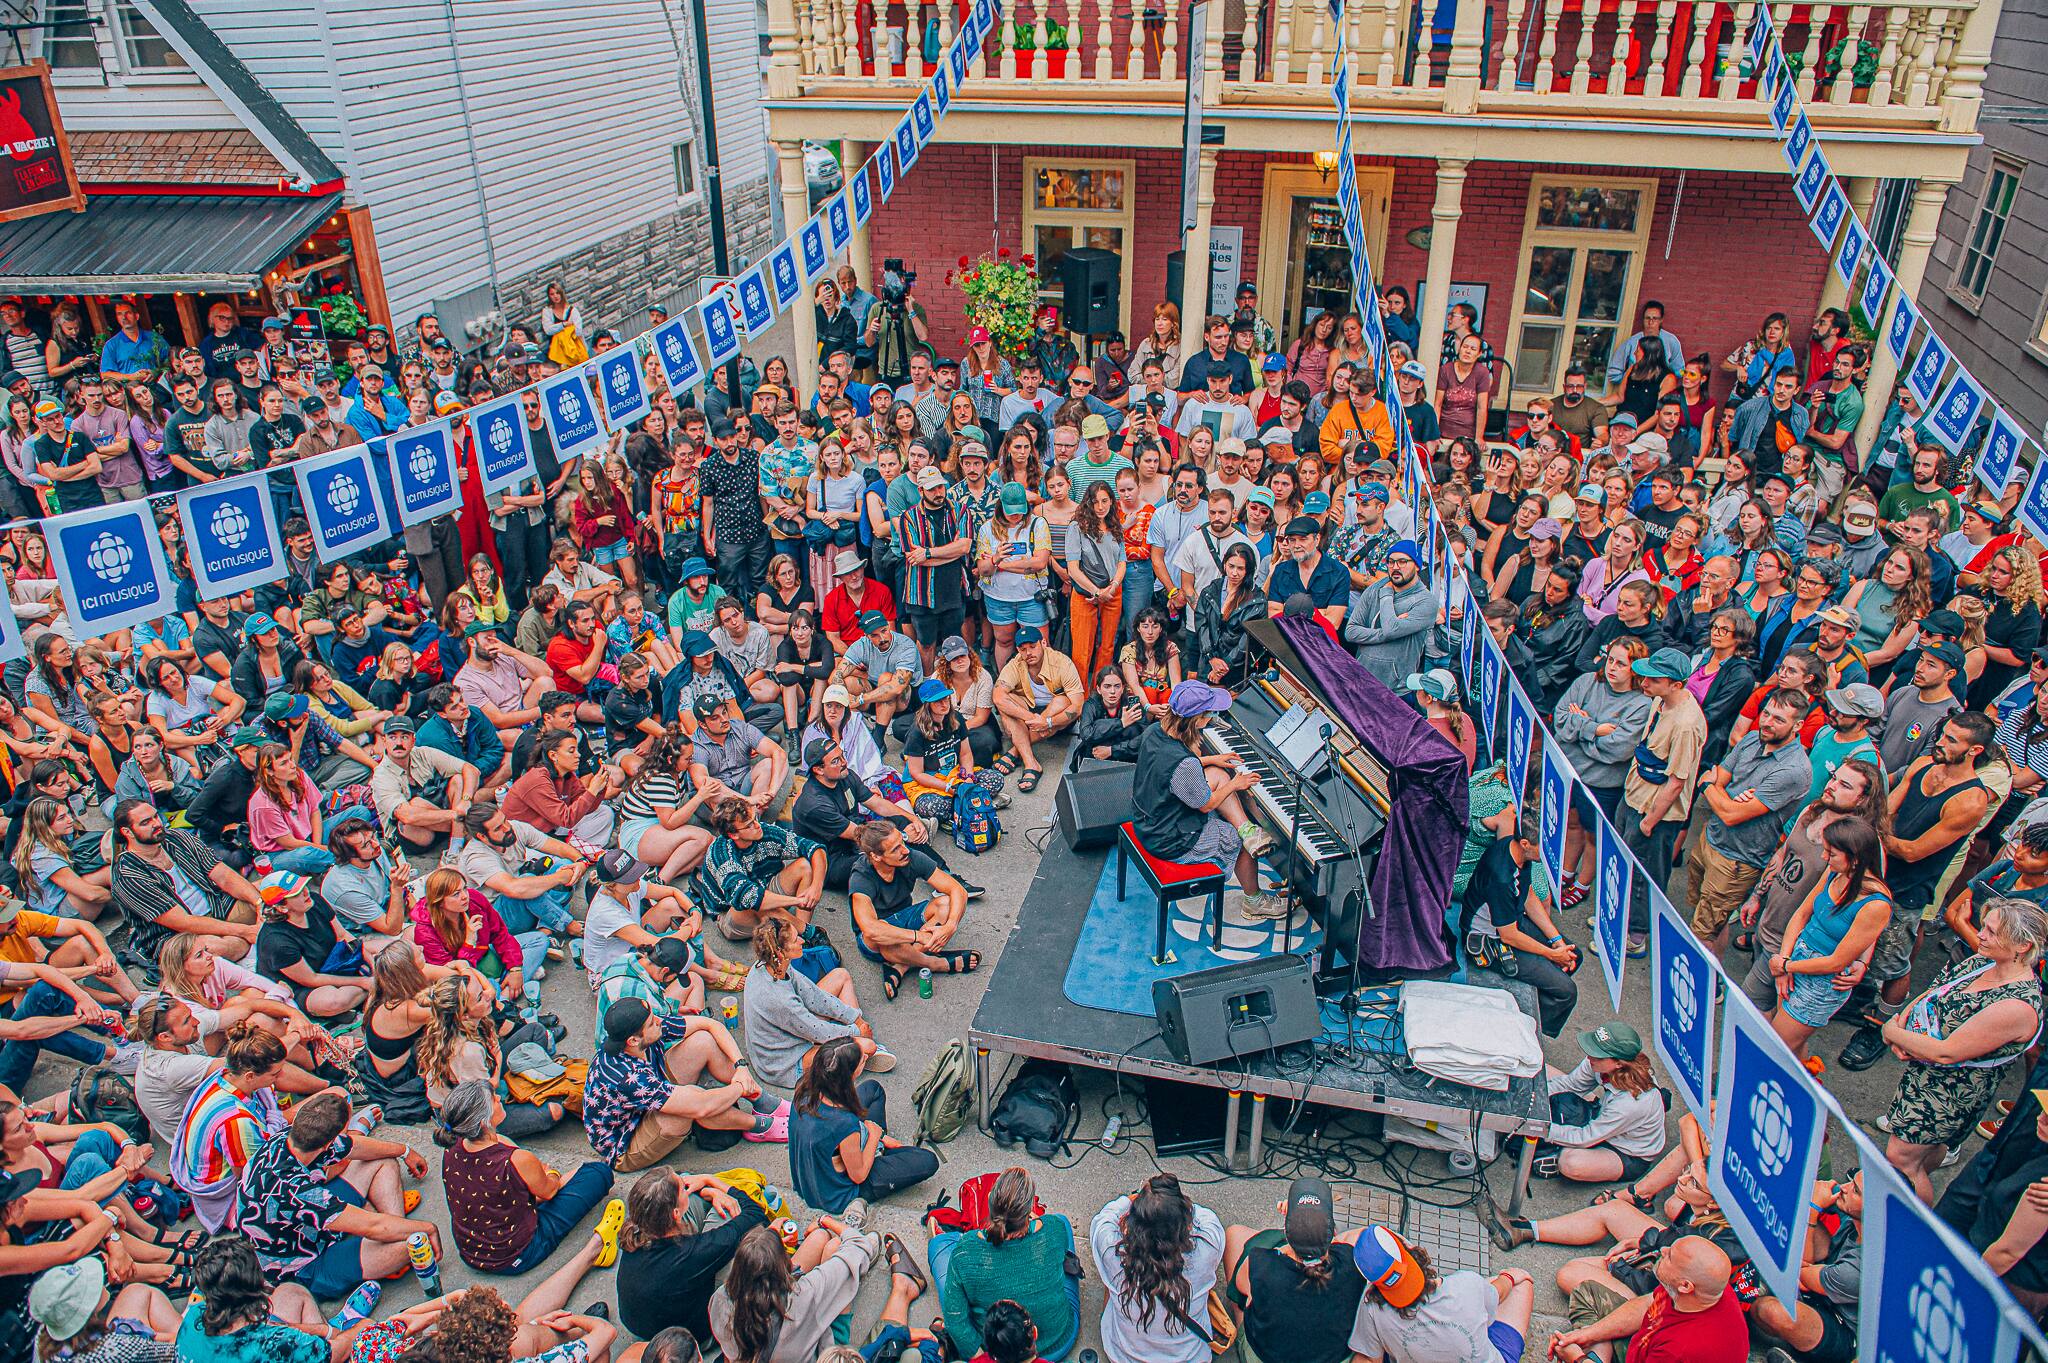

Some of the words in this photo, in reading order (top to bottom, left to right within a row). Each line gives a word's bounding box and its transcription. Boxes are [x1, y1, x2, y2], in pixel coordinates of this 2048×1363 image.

[13, 137, 49, 153] VACHE
[1209, 241, 1219, 251] ai
[558, 433, 568, 442] ICI
[567, 420, 595, 438] musique
[487, 463, 497, 473] ICI
[496, 451, 525, 469] musique
[406, 493, 417, 504] ICI
[416, 482, 450, 501] musique
[324, 527, 338, 539] ICI
[337, 512, 376, 534] musique
[207, 560, 222, 572] ICI
[221, 547, 269, 569] musique
[81, 597, 99, 610] ICI
[99, 581, 155, 606] musique
[1662, 1014, 1671, 1039] ICI
[1671, 1028, 1702, 1089] musique
[1726, 1145, 1742, 1177] ICI
[1740, 1165, 1788, 1249] musique
